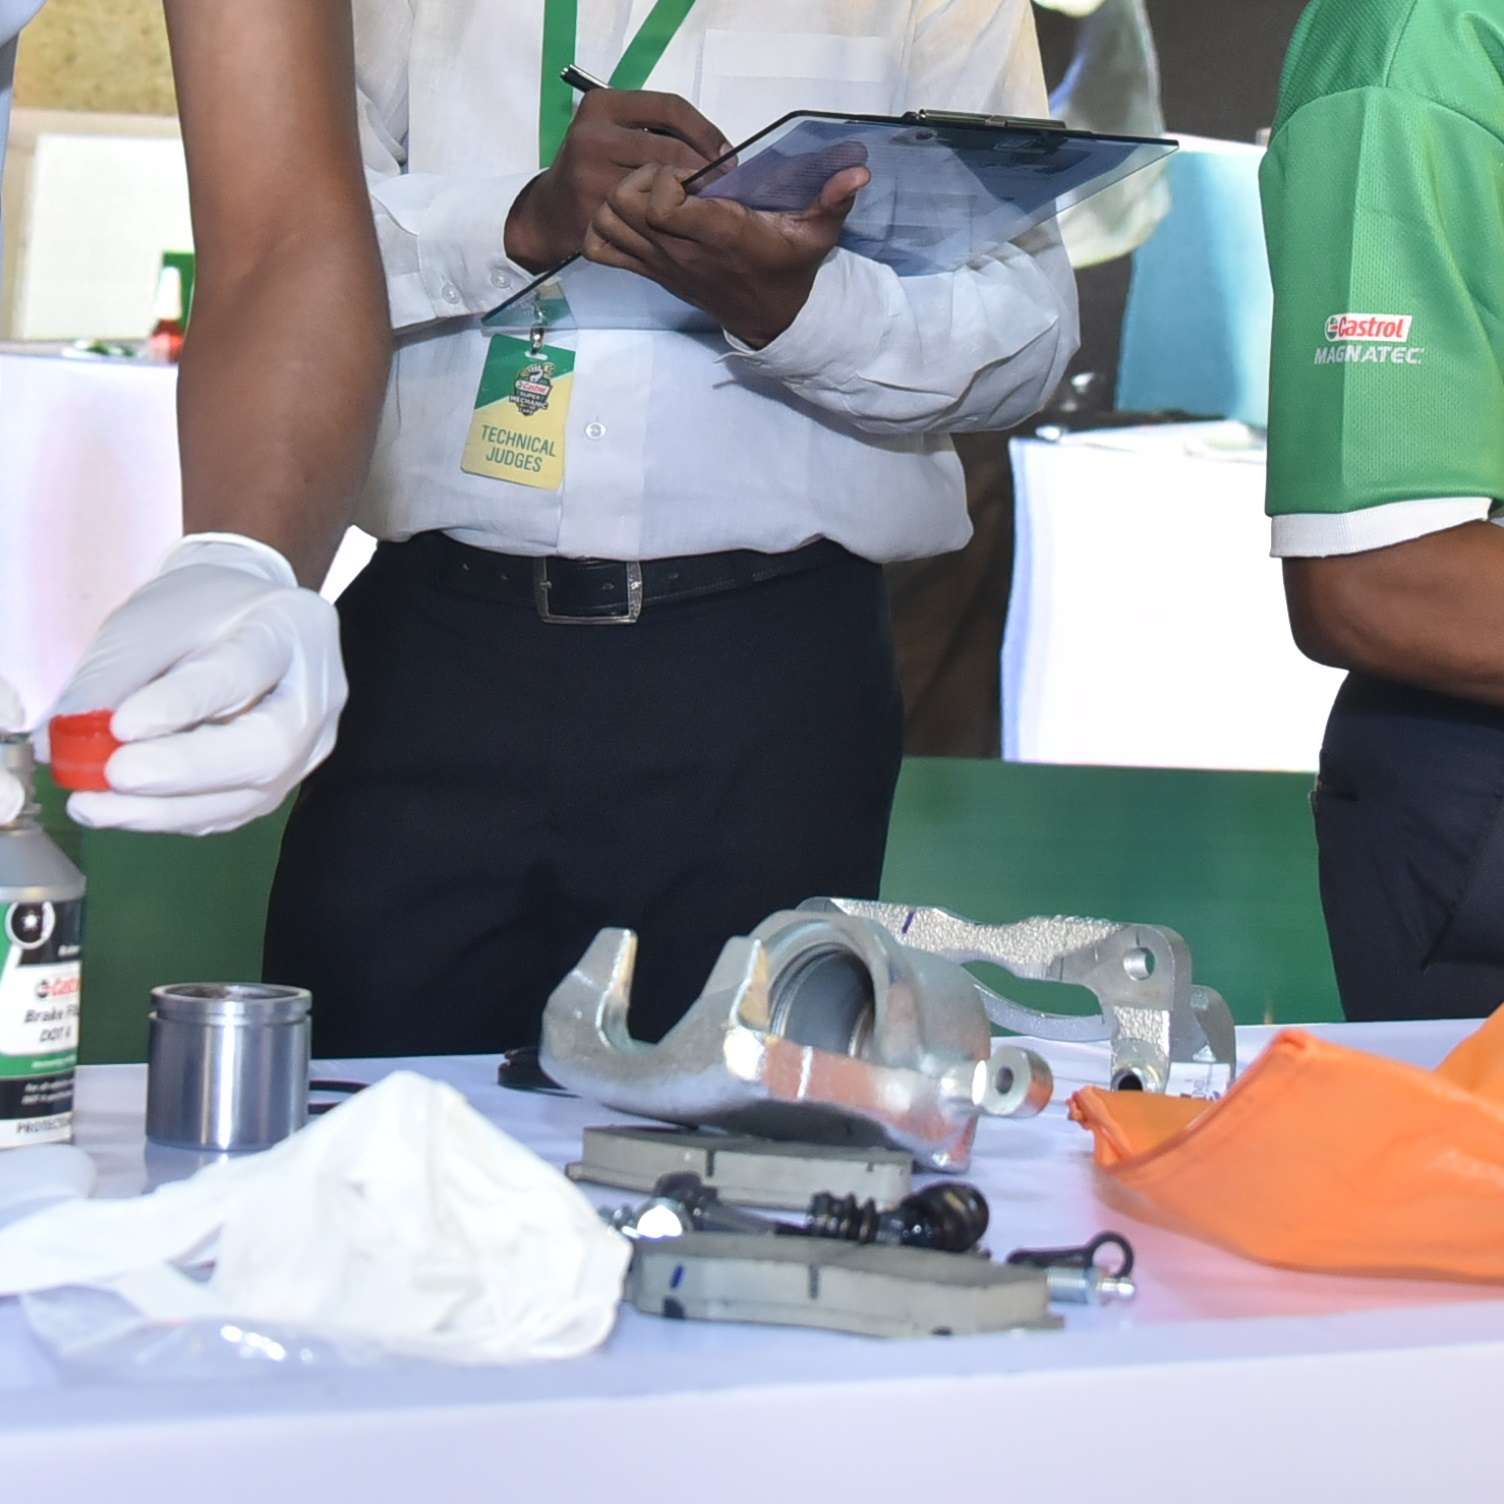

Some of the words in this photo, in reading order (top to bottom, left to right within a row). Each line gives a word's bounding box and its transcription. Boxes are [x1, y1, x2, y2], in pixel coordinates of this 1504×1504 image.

[1339, 316, 1404, 338] Castrol
[1314, 344, 1425, 365] MAGNATEC
[481, 425, 556, 457] TECHNICAL
[486, 447, 543, 472] JUDGES
